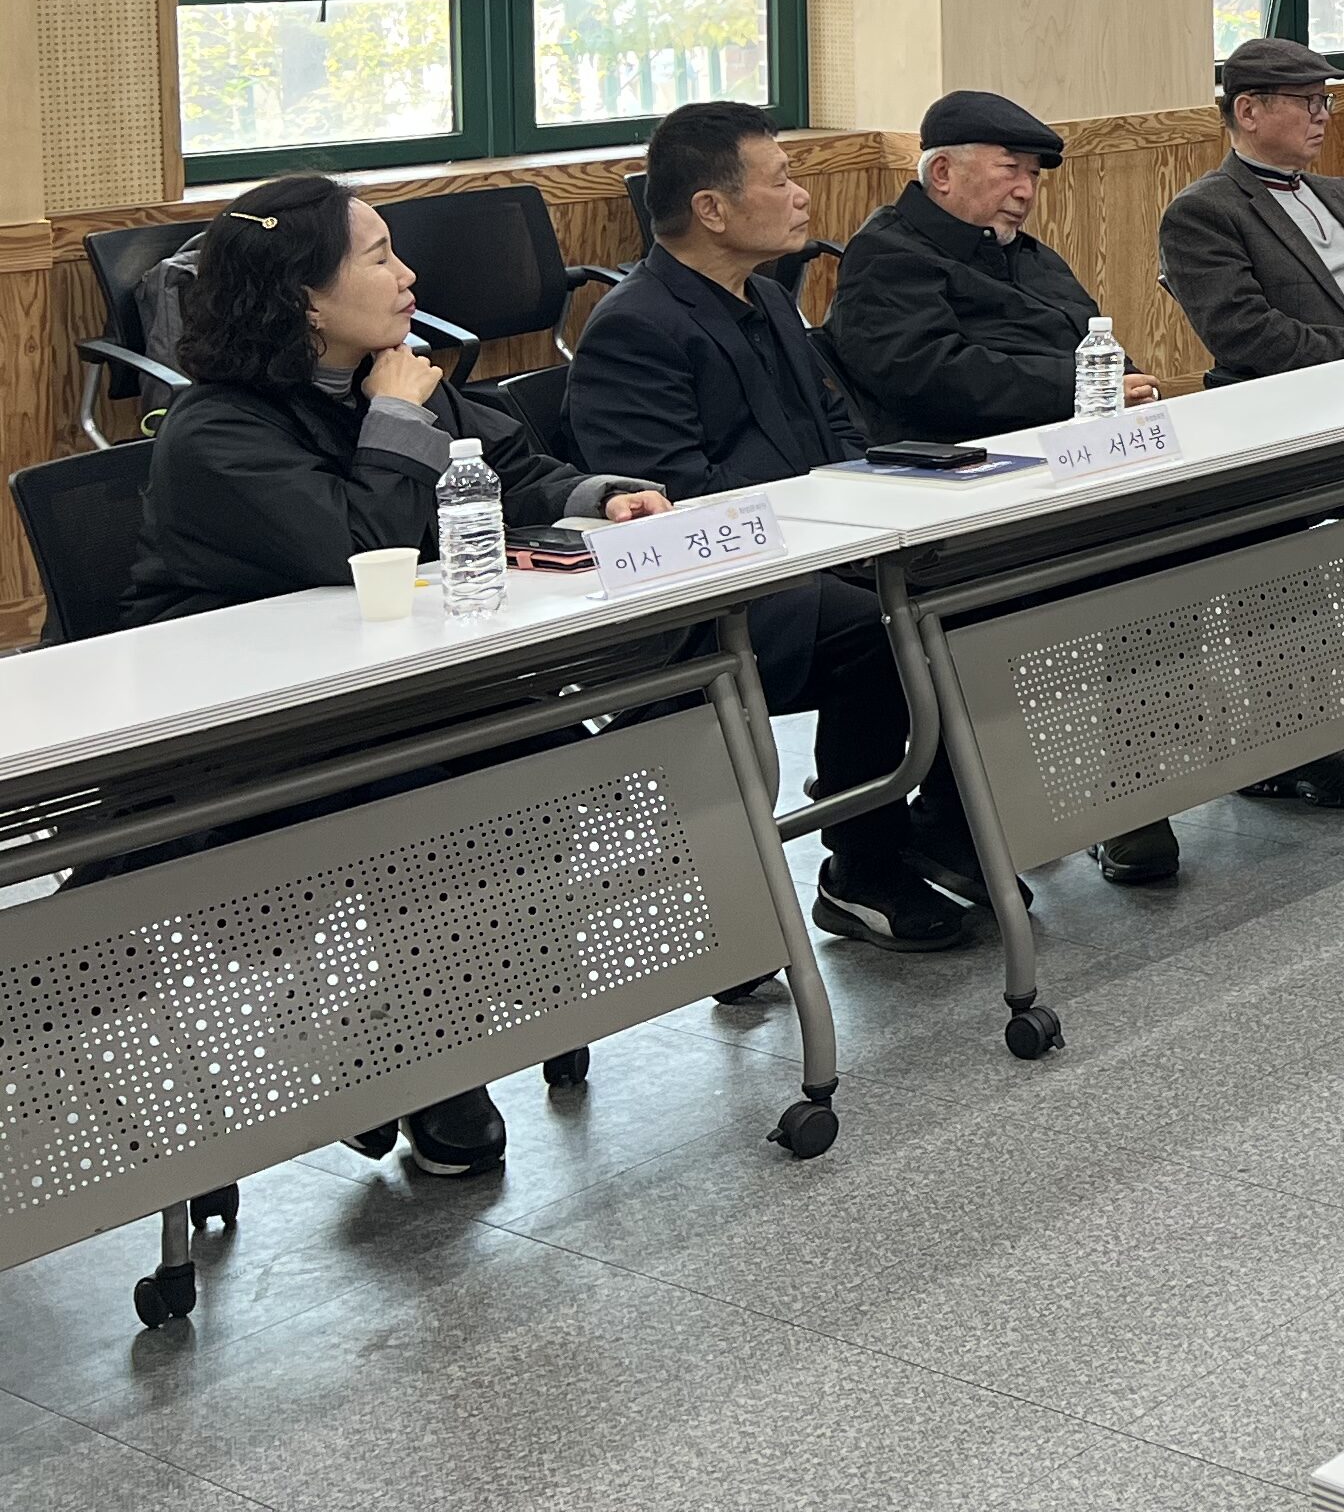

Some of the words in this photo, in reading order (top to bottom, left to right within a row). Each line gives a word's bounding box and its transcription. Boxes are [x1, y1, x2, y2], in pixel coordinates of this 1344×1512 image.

[1058, 445, 1093, 468] 이사
[1109, 424, 1166, 457] 서석붕
[615, 545, 663, 573] 이사
[684, 516, 767, 559] 정은경
